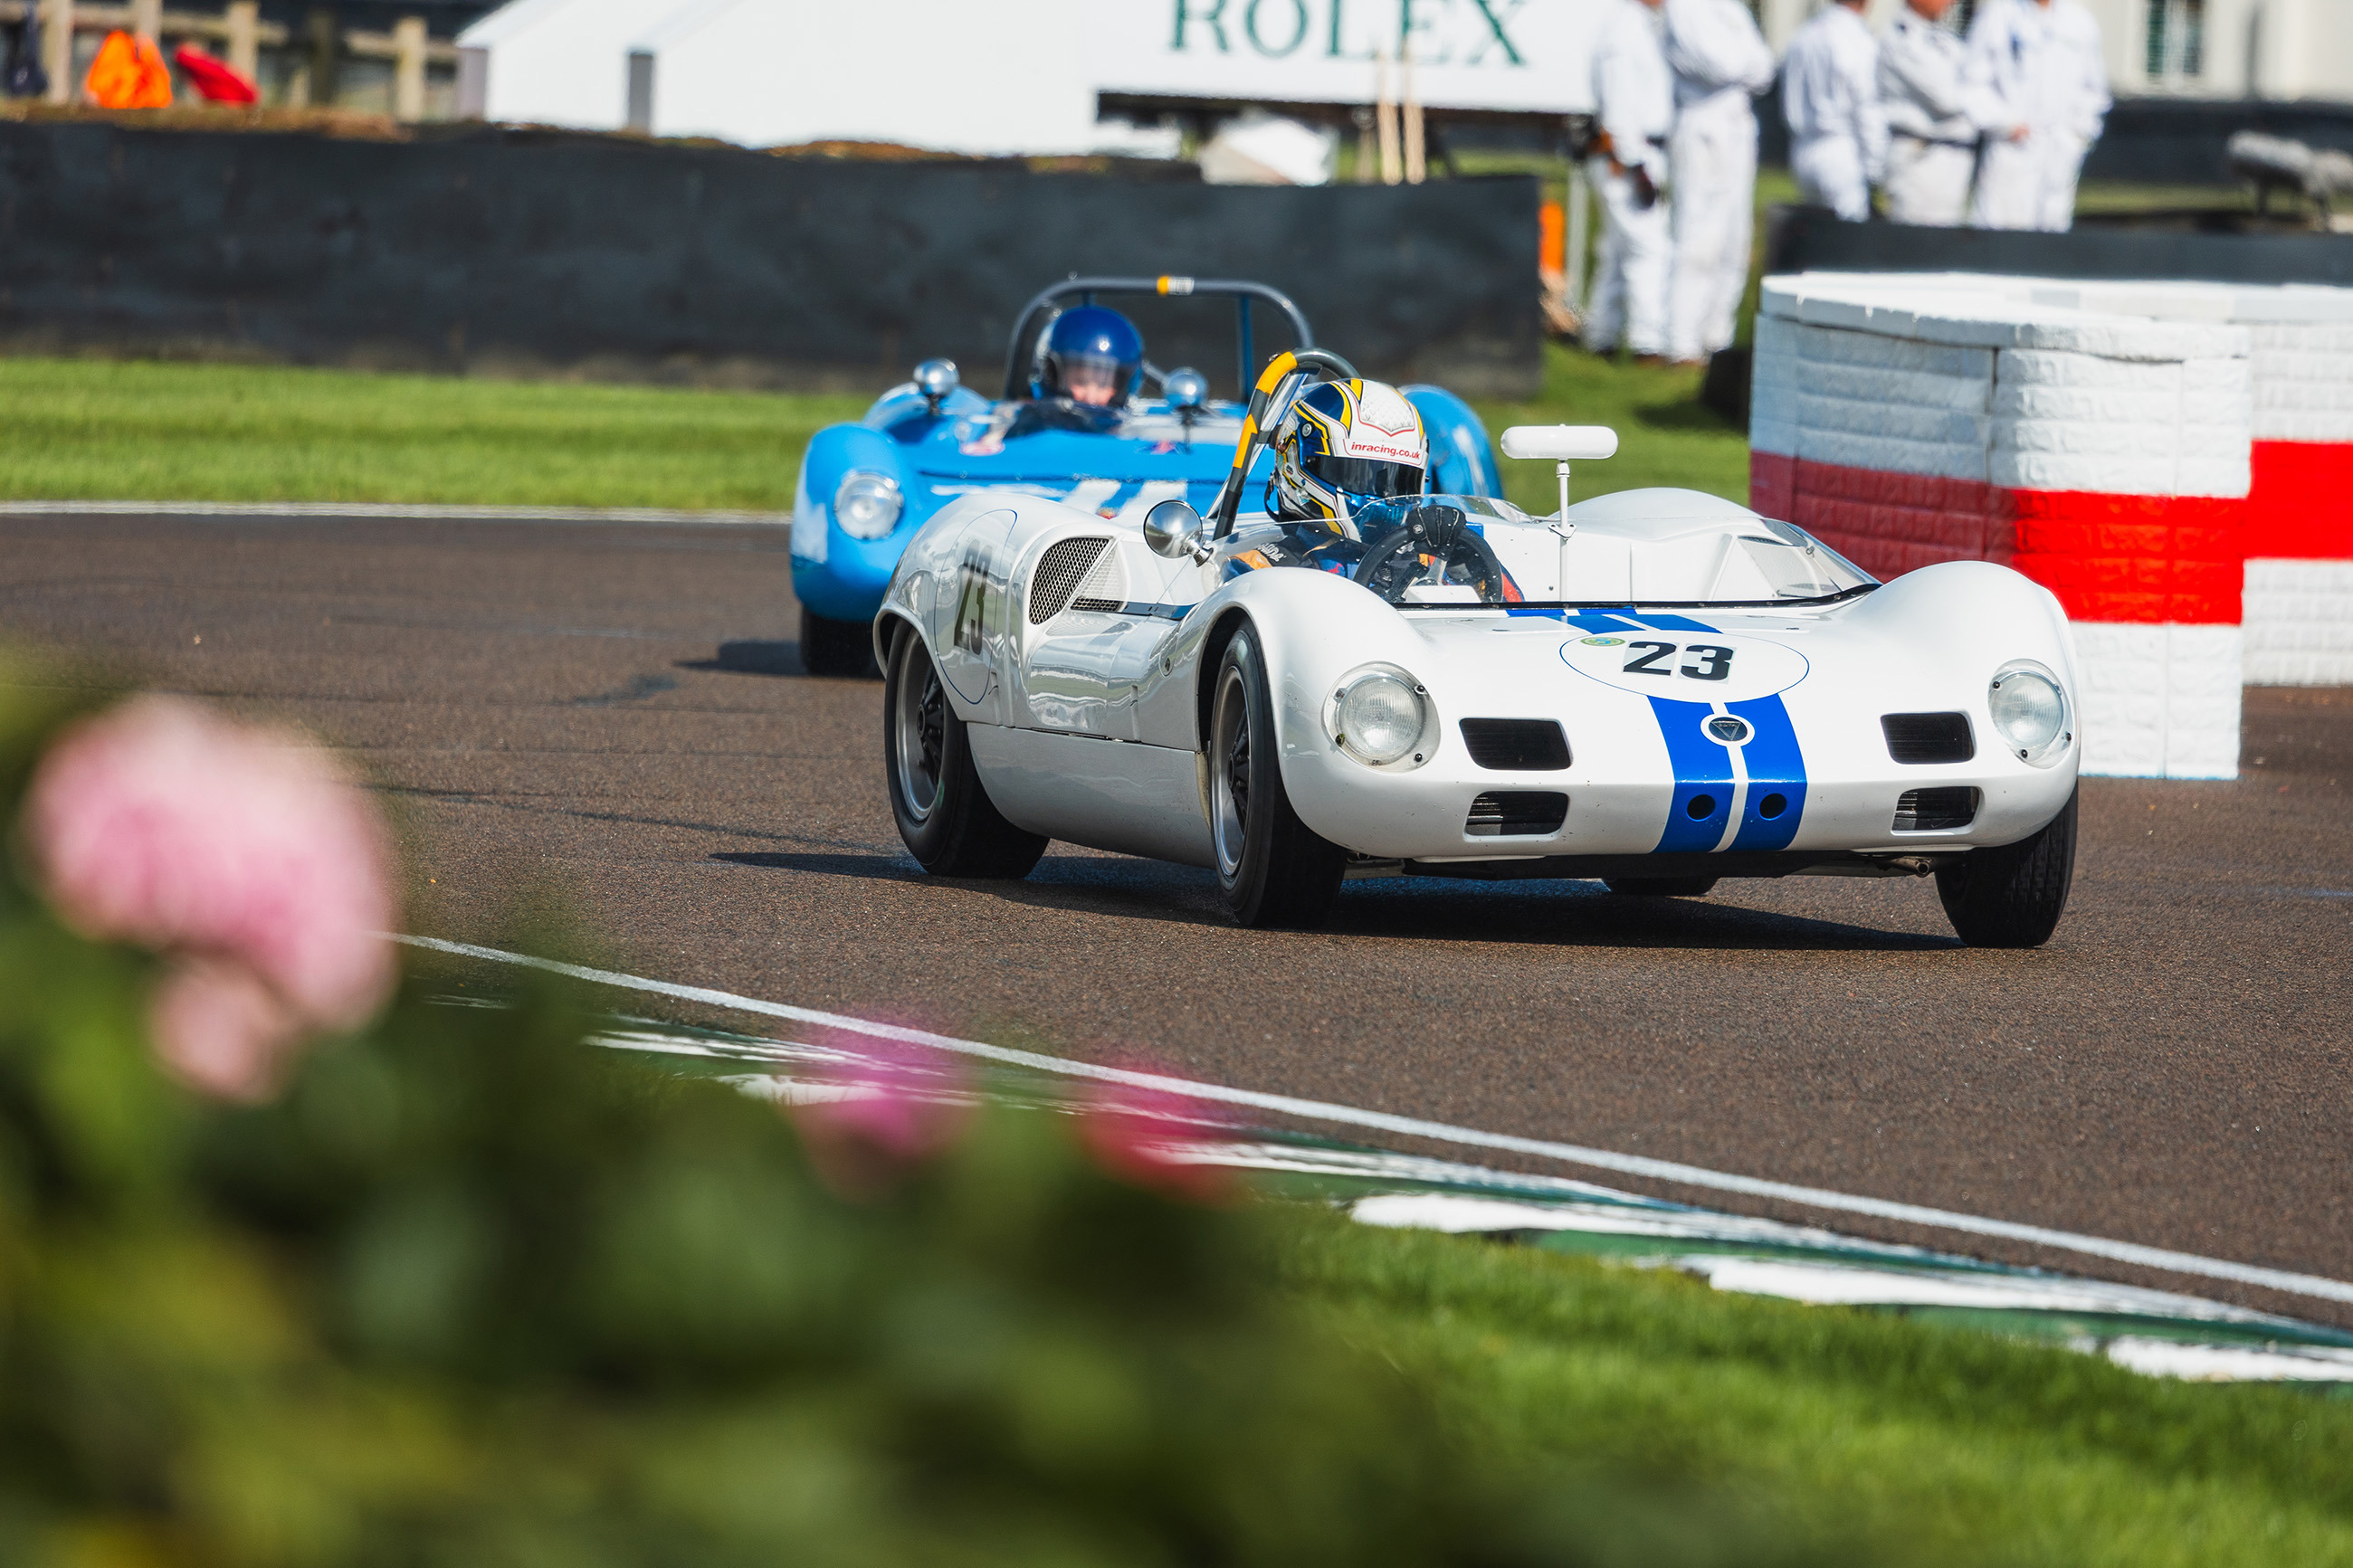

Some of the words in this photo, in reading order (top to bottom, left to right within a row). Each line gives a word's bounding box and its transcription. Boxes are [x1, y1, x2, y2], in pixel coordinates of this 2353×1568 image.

[1170, 0, 1528, 64] ROLEX
[1351, 442, 1420, 459] inracing.co.uk
[954, 538, 993, 655] 23
[1623, 641, 1734, 681] 23
